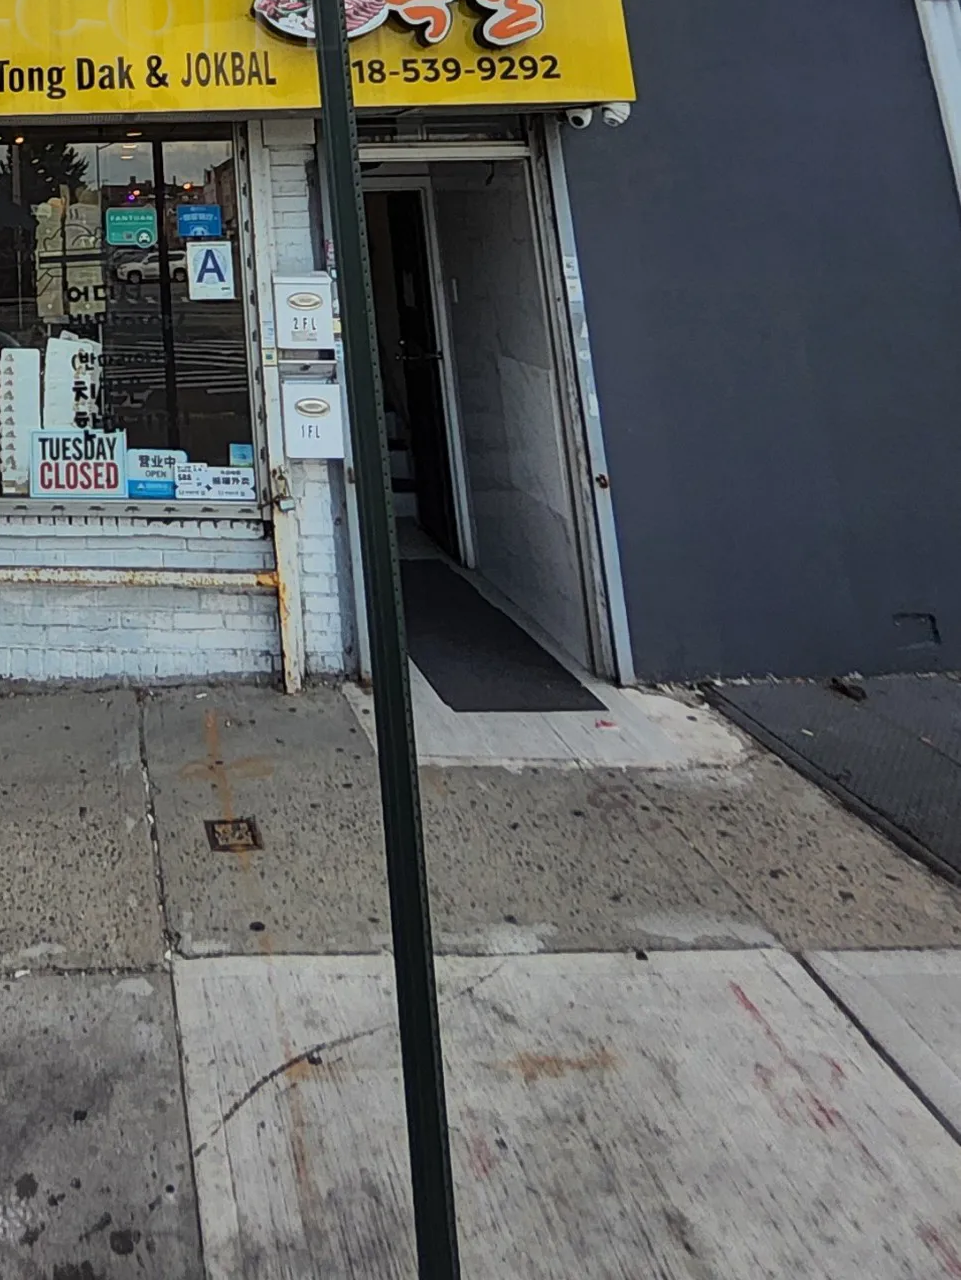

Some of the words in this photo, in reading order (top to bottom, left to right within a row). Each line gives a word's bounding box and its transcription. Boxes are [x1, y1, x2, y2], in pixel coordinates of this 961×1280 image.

[76, 56, 136, 91] Dak
[145, 54, 170, 88] &
[180, 50, 277, 88] JOKBAL
[351, 54, 562, 85] 18-539-9292
[196, 249, 226, 283] A
[38, 436, 117, 461] TUESDAY
[40, 462, 119, 490] CLOSED
[145, 470, 167, 478] OPEN
